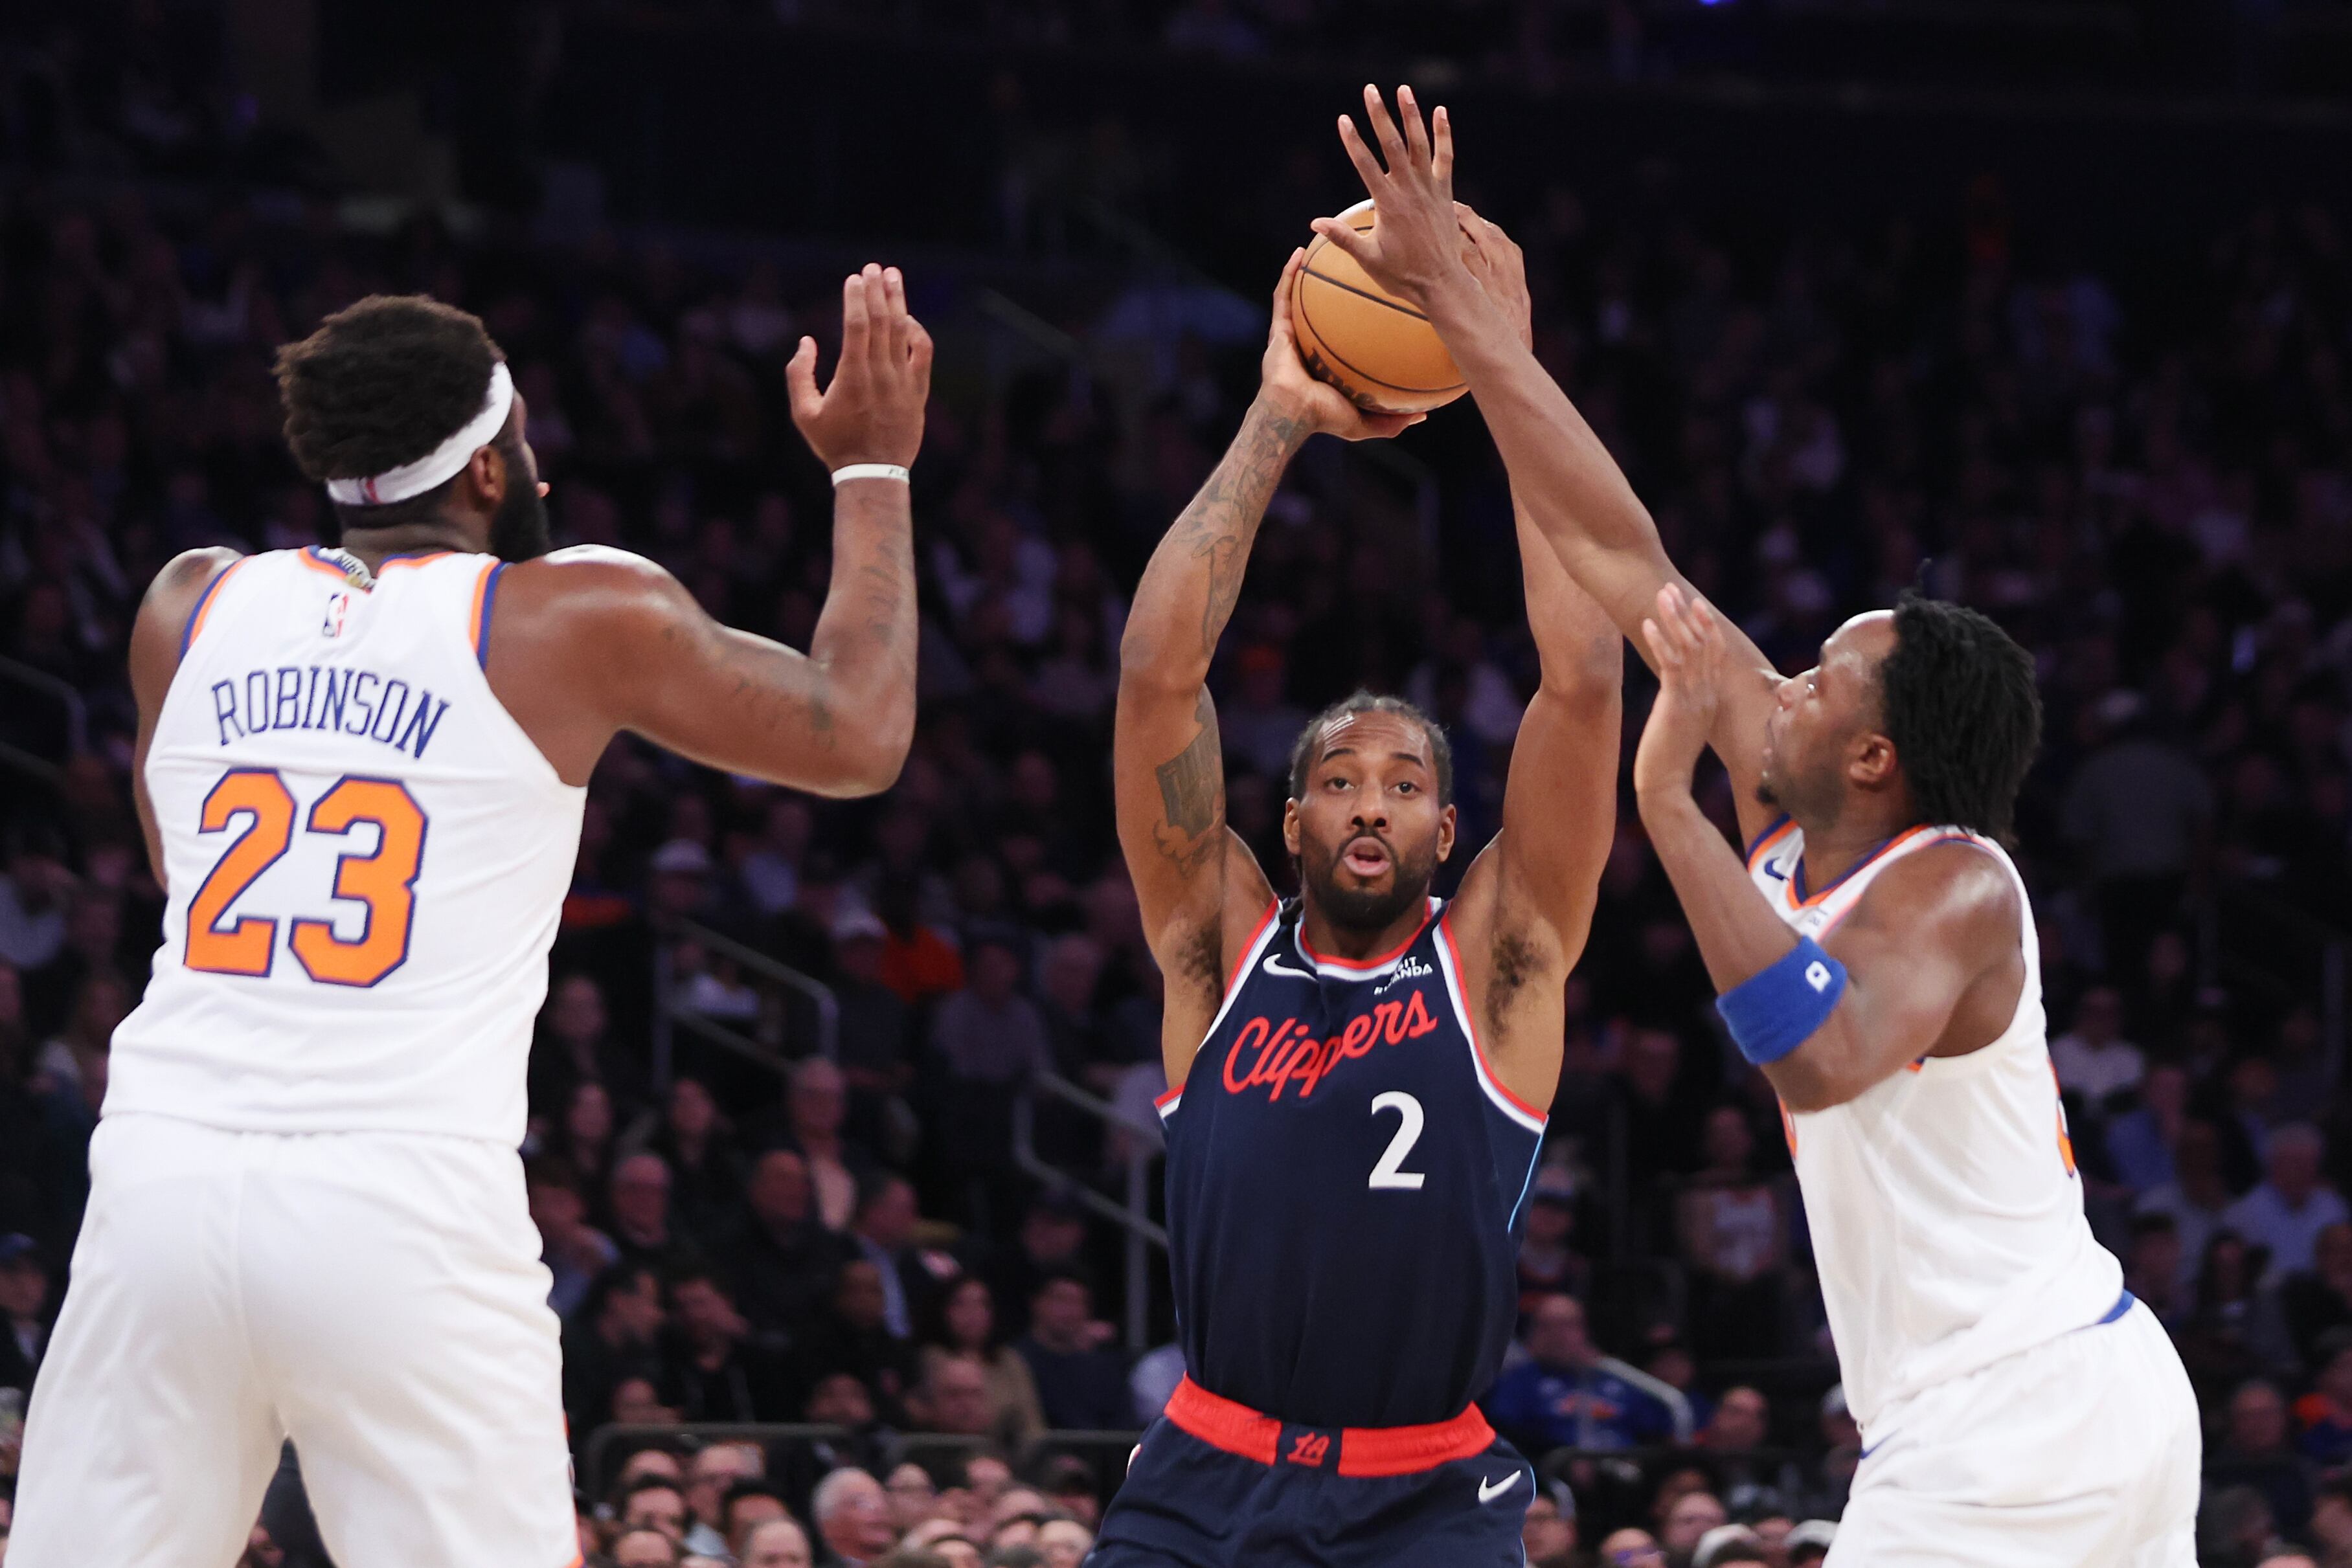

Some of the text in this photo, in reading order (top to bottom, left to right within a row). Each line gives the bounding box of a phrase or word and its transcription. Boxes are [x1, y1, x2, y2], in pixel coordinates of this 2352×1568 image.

[212, 666, 452, 760] ROBINSON
[183, 767, 429, 989] 23
[1223, 989, 1439, 1103] Clippers
[1368, 1090, 1425, 1189] 2
